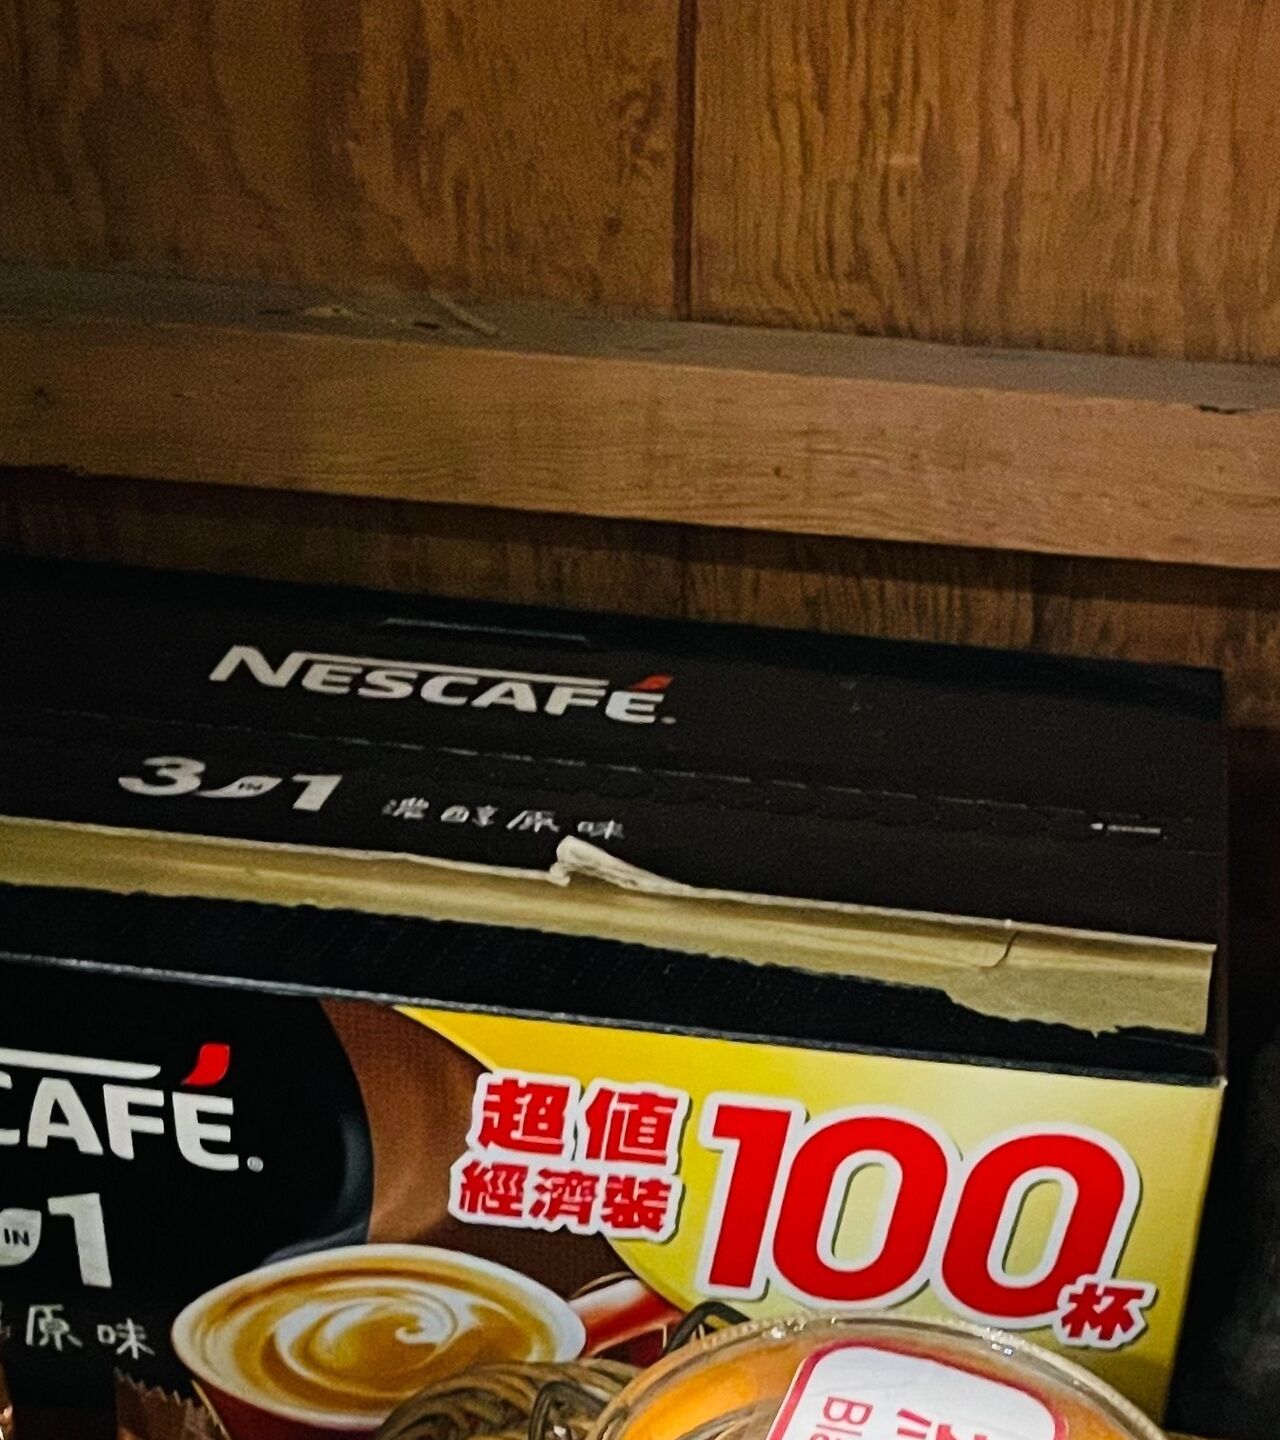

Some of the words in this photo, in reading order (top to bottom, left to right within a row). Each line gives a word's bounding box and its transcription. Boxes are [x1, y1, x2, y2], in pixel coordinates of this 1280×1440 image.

[209, 645, 672, 724] NESCAFÉ
[476, 1077, 679, 1166] 超值
[458, 1161, 673, 1233] 經濟裝
[707, 1104, 1125, 1319] 100
[1059, 1281, 1146, 1341] 杯
